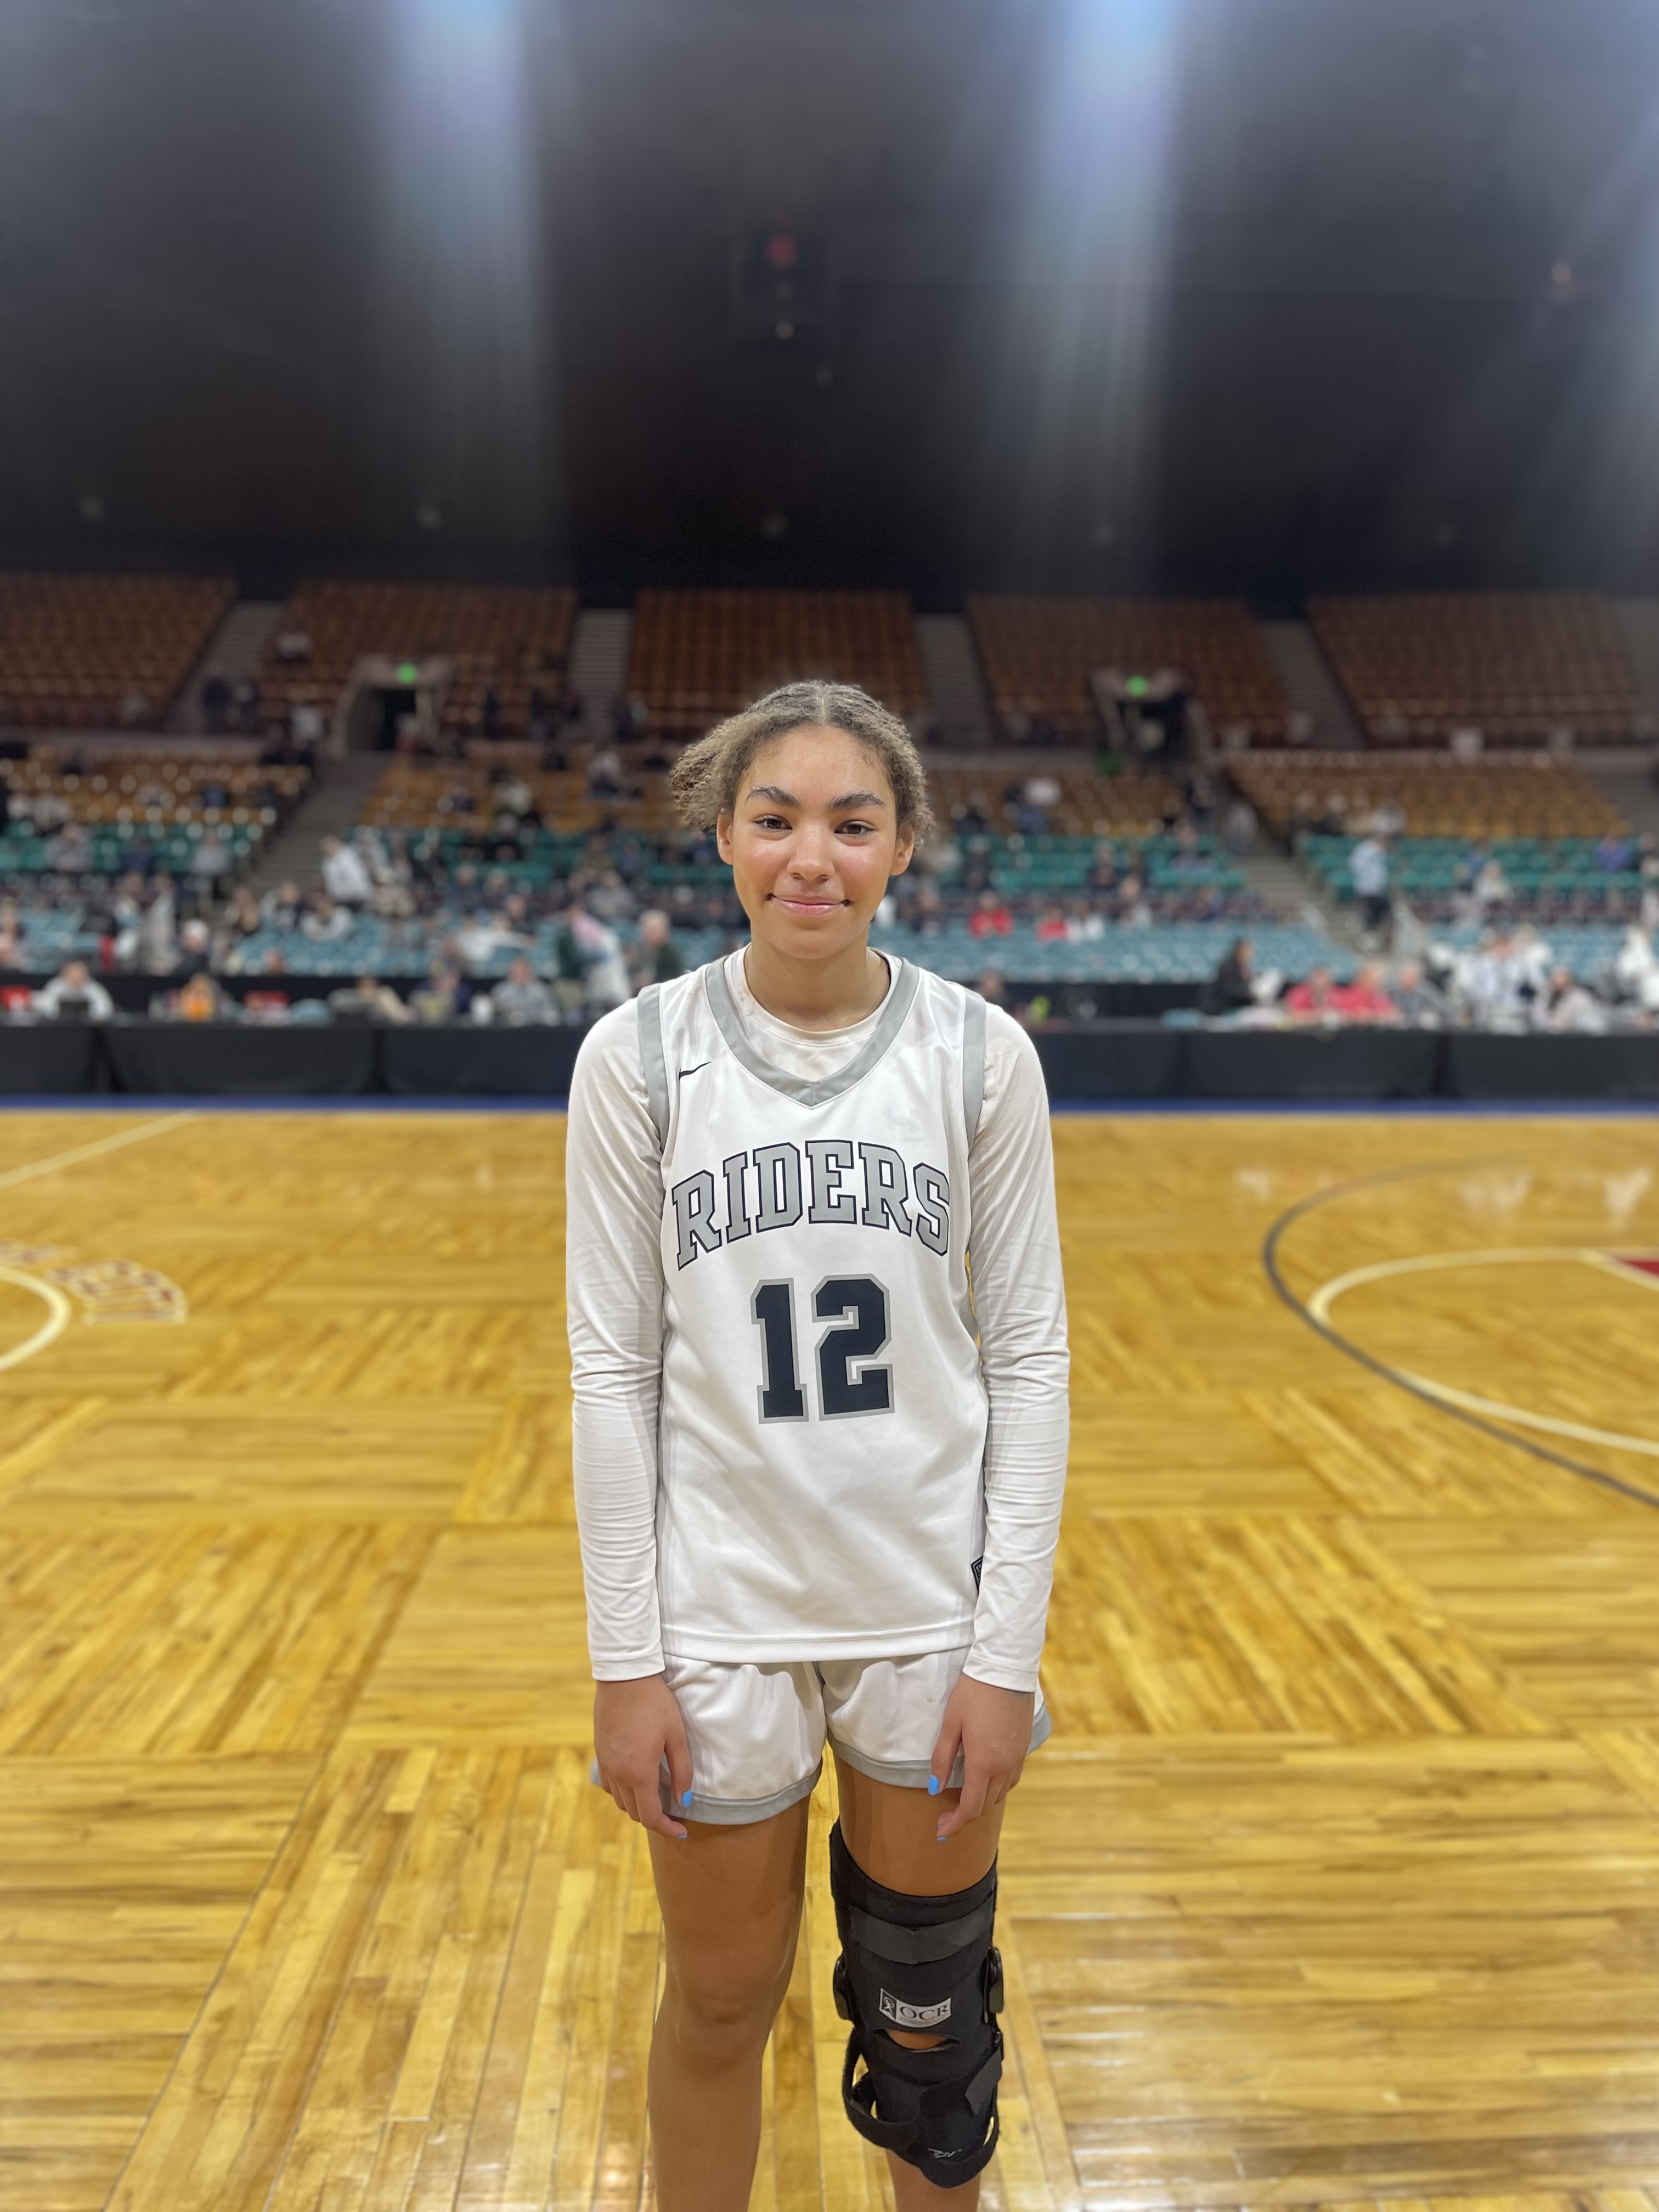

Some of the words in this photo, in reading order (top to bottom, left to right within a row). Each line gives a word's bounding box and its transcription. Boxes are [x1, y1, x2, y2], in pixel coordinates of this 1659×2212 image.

[671, 1139, 950, 1272] RIDERS
[750, 1273, 895, 1425] 12
[900, 2005, 949, 2021] OCR
